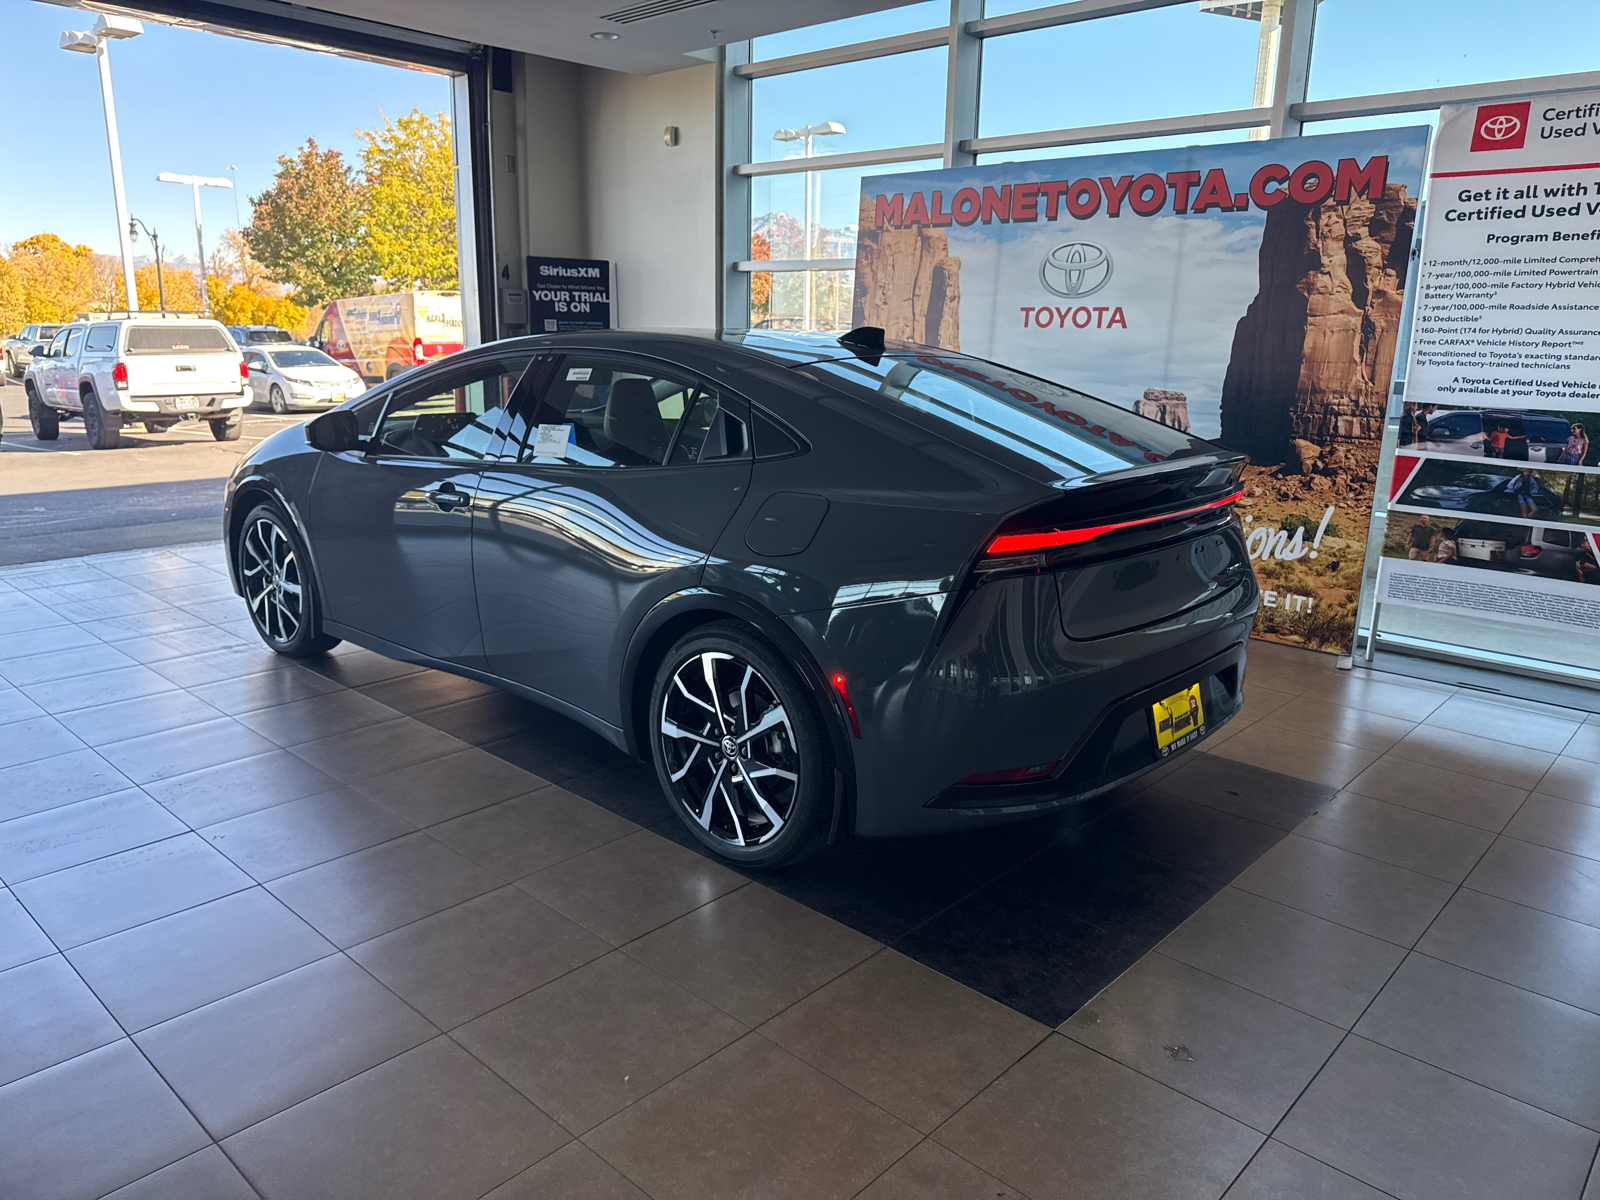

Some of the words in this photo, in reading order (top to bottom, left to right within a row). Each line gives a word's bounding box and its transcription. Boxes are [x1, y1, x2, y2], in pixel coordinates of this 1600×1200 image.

[1540, 122, 1587, 139] Used
[875, 155, 1390, 229] MALONETOYOTA.COM
[1457, 189, 1491, 203] Get
[1495, 187, 1510, 200] it
[1513, 184, 1539, 200] all
[1543, 182, 1588, 198] with
[1444, 205, 1527, 222] Certified
[1531, 202, 1582, 218] Used
[1586, 201, 1600, 216] V
[1486, 233, 1549, 246] Program
[1428, 257, 1522, 267] 12-month/12,000-mile
[1523, 256, 1557, 264] Limited
[501, 264, 510, 281] 4
[539, 265, 600, 278] SiriusXM
[1427, 269, 1512, 280] 7-year/100,000-mile
[1513, 269, 1547, 277] Limited
[1548, 267, 1599, 276] Powertrain
[1425, 282, 1509, 291] 8-year/100,000-mile
[1511, 281, 1543, 290] Factory
[1545, 280, 1576, 290] Hybrid
[532, 290, 570, 302] YOUR
[572, 291, 610, 303] TRIAL
[1424, 292, 1454, 300] Battery
[554, 302, 568, 313] IS
[570, 302, 591, 313] ON
[1423, 303, 1507, 312] 7-year/100,000-mile
[1509, 303, 1550, 311] Roadside
[1551, 303, 1600, 311] Assistance
[1019, 306, 1128, 330] TOYOTA
[1422, 315, 1432, 323] $0
[1459, 327, 1477, 335] (174
[1491, 327, 1523, 336] Hybrid)
[1524, 327, 1557, 336] Quality
[1419, 338, 1437, 346] Free
[1476, 339, 1507, 347] Vehicle
[1508, 339, 1540, 349] History
[1418, 350, 1477, 358] Reconditioned
[1524, 352, 1562, 361] exacting
[1416, 359, 1427, 367] by
[1428, 359, 1455, 367] Toyota
[1456, 360, 1520, 369] factory-trained
[1521, 361, 1571, 370] technicians
[1452, 376, 1460, 384] A
[1461, 376, 1491, 386] Toyota
[1492, 378, 1534, 387] Certified
[1535, 379, 1560, 388] Used
[1561, 380, 1597, 390] Vehicle
[1437, 385, 1457, 394] only
[1458, 386, 1499, 395] available
[1511, 389, 1534, 397] your
[1535, 389, 1567, 399] Toyota
[1260, 589, 1278, 608] E
[1285, 593, 1314, 614] IT!
